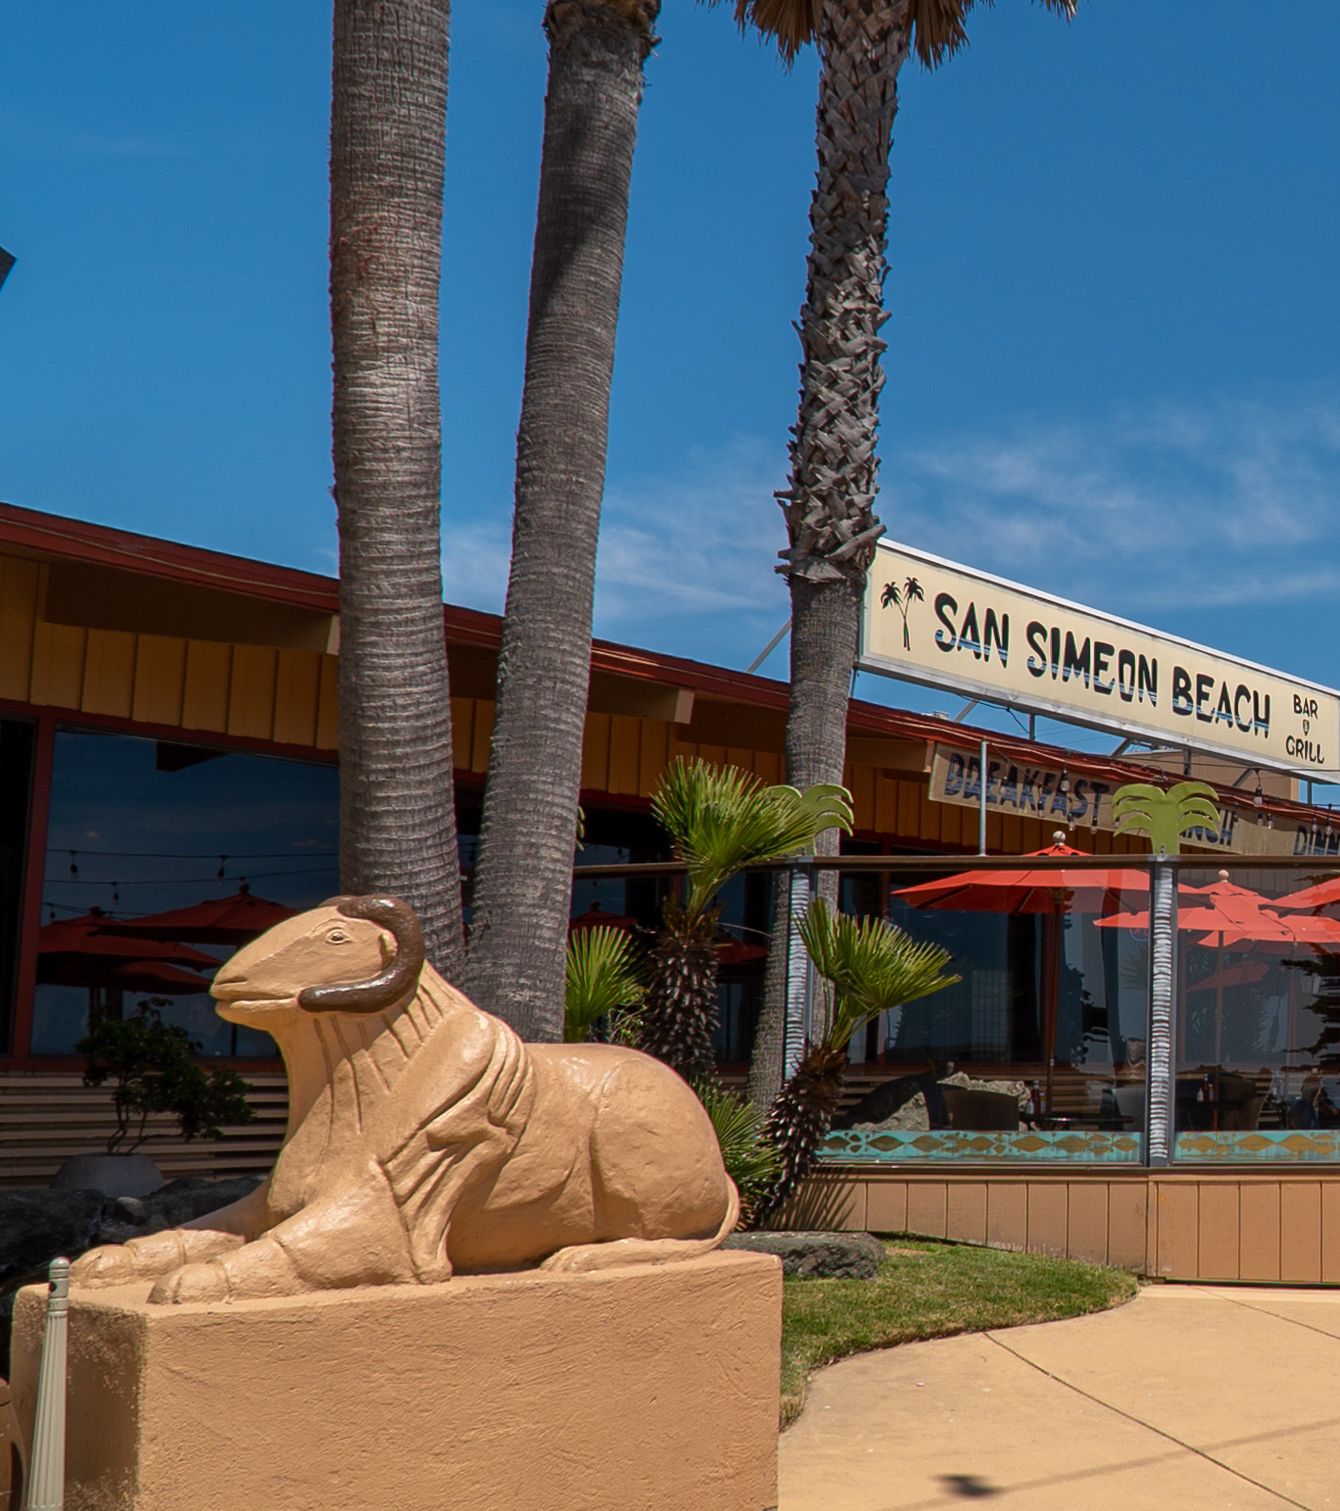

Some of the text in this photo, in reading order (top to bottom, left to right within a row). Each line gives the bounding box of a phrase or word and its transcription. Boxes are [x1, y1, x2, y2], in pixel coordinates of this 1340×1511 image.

[934, 592, 1271, 739] SAN SIMEON BEACH
[1293, 693, 1318, 719] BAR
[1285, 735, 1325, 764] GRILL
